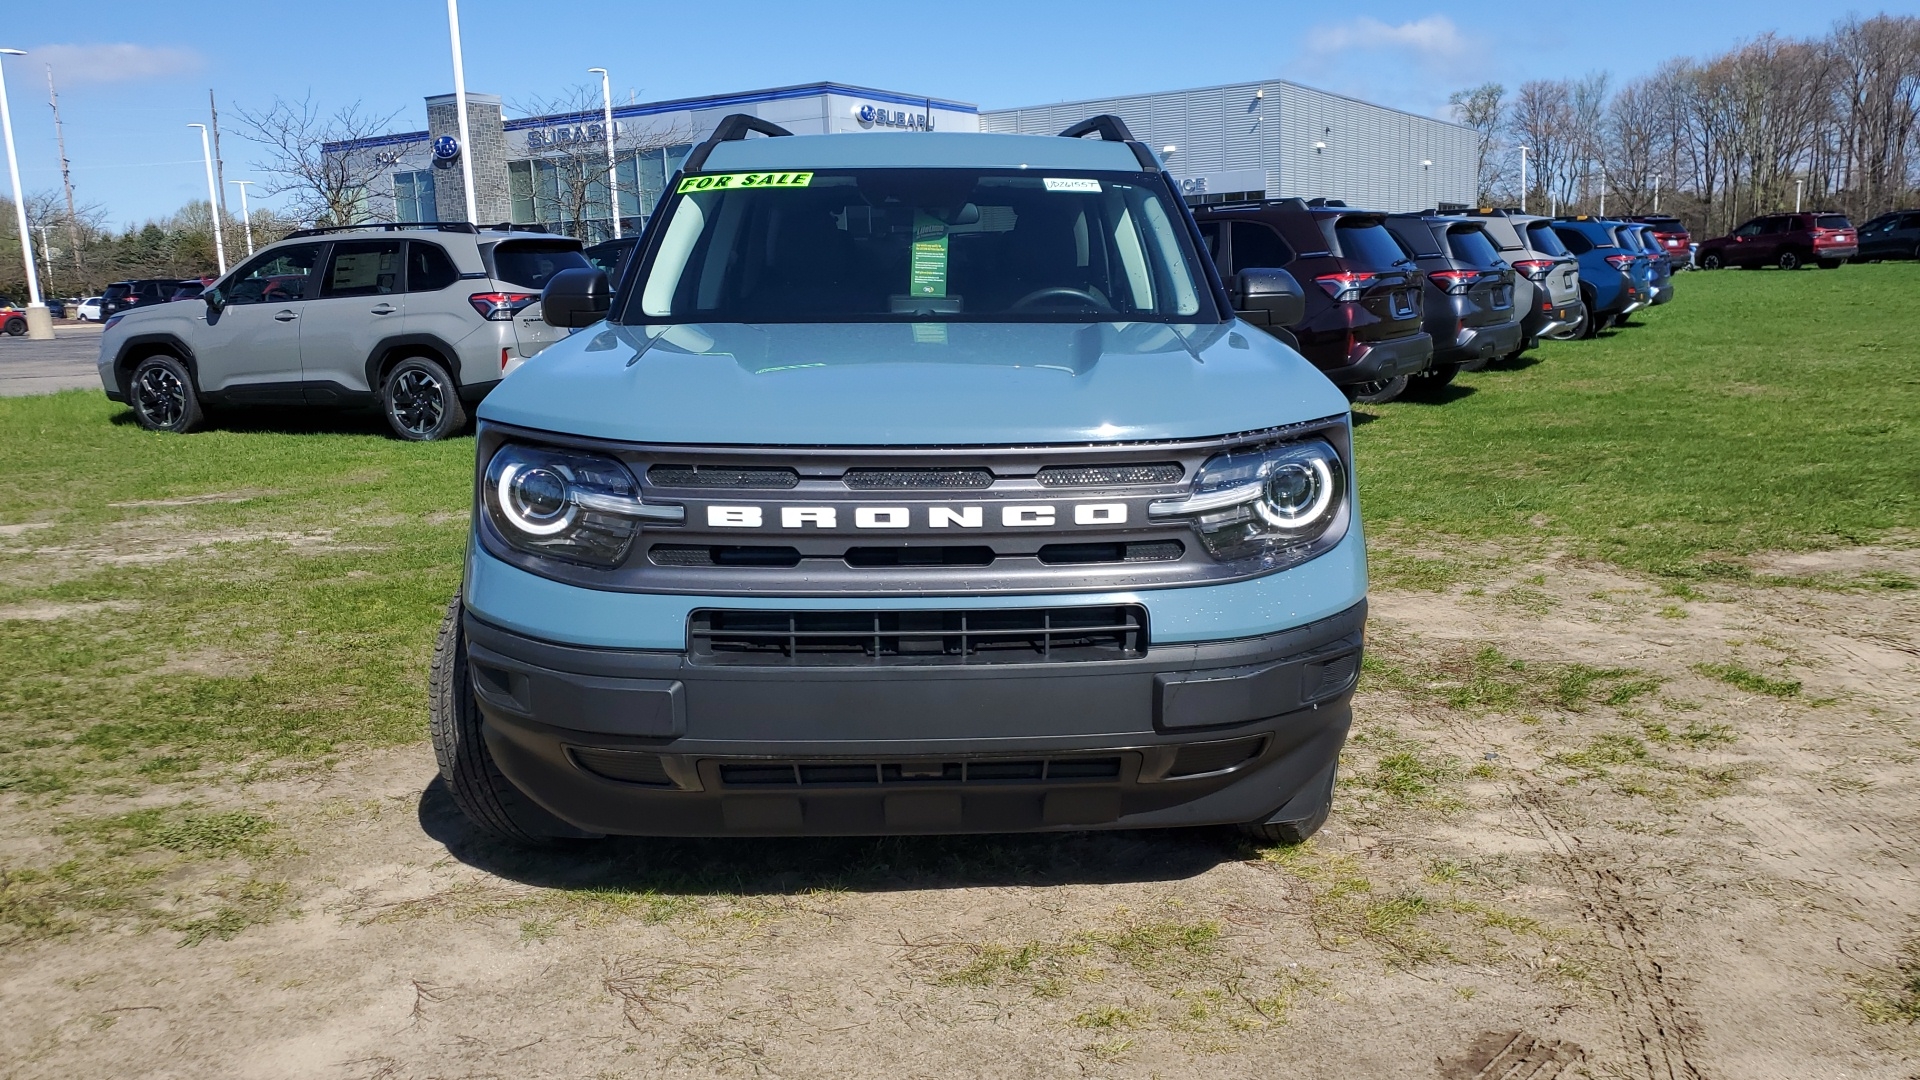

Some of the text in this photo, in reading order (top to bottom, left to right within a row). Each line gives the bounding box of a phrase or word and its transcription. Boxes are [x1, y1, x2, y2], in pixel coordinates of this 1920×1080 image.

[877, 109, 935, 131] SUBARU
[527, 122, 619, 148] SUBARU
[680, 174, 810, 191] FOR SALE
[707, 503, 1127, 528] BRONCO
